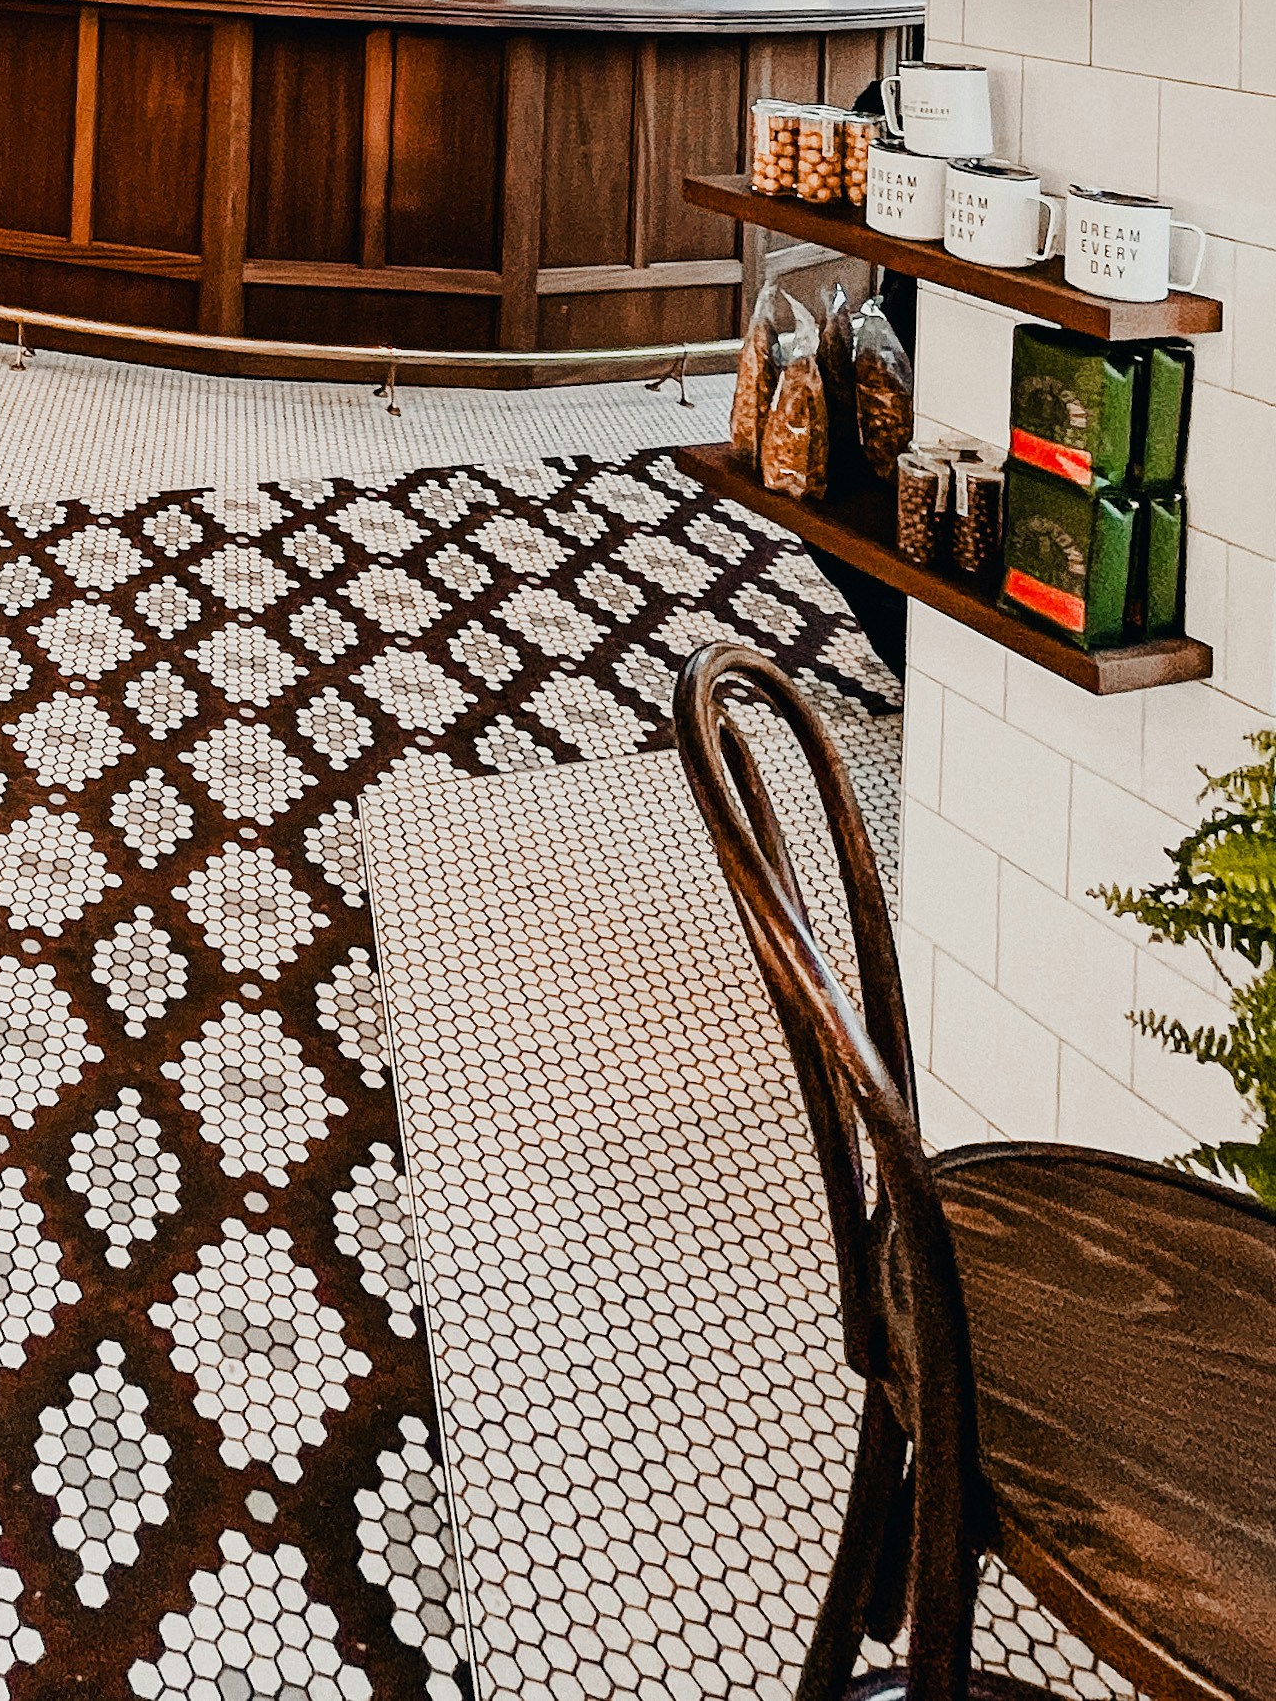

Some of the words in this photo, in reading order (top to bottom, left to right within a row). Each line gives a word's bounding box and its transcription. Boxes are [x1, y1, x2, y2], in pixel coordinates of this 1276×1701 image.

[872, 167, 918, 188] DREAM
[877, 202, 904, 219] DAY
[1081, 220, 1140, 243] DREAM
[1081, 238, 1138, 261] EVERY
[1090, 259, 1126, 279] DAY
